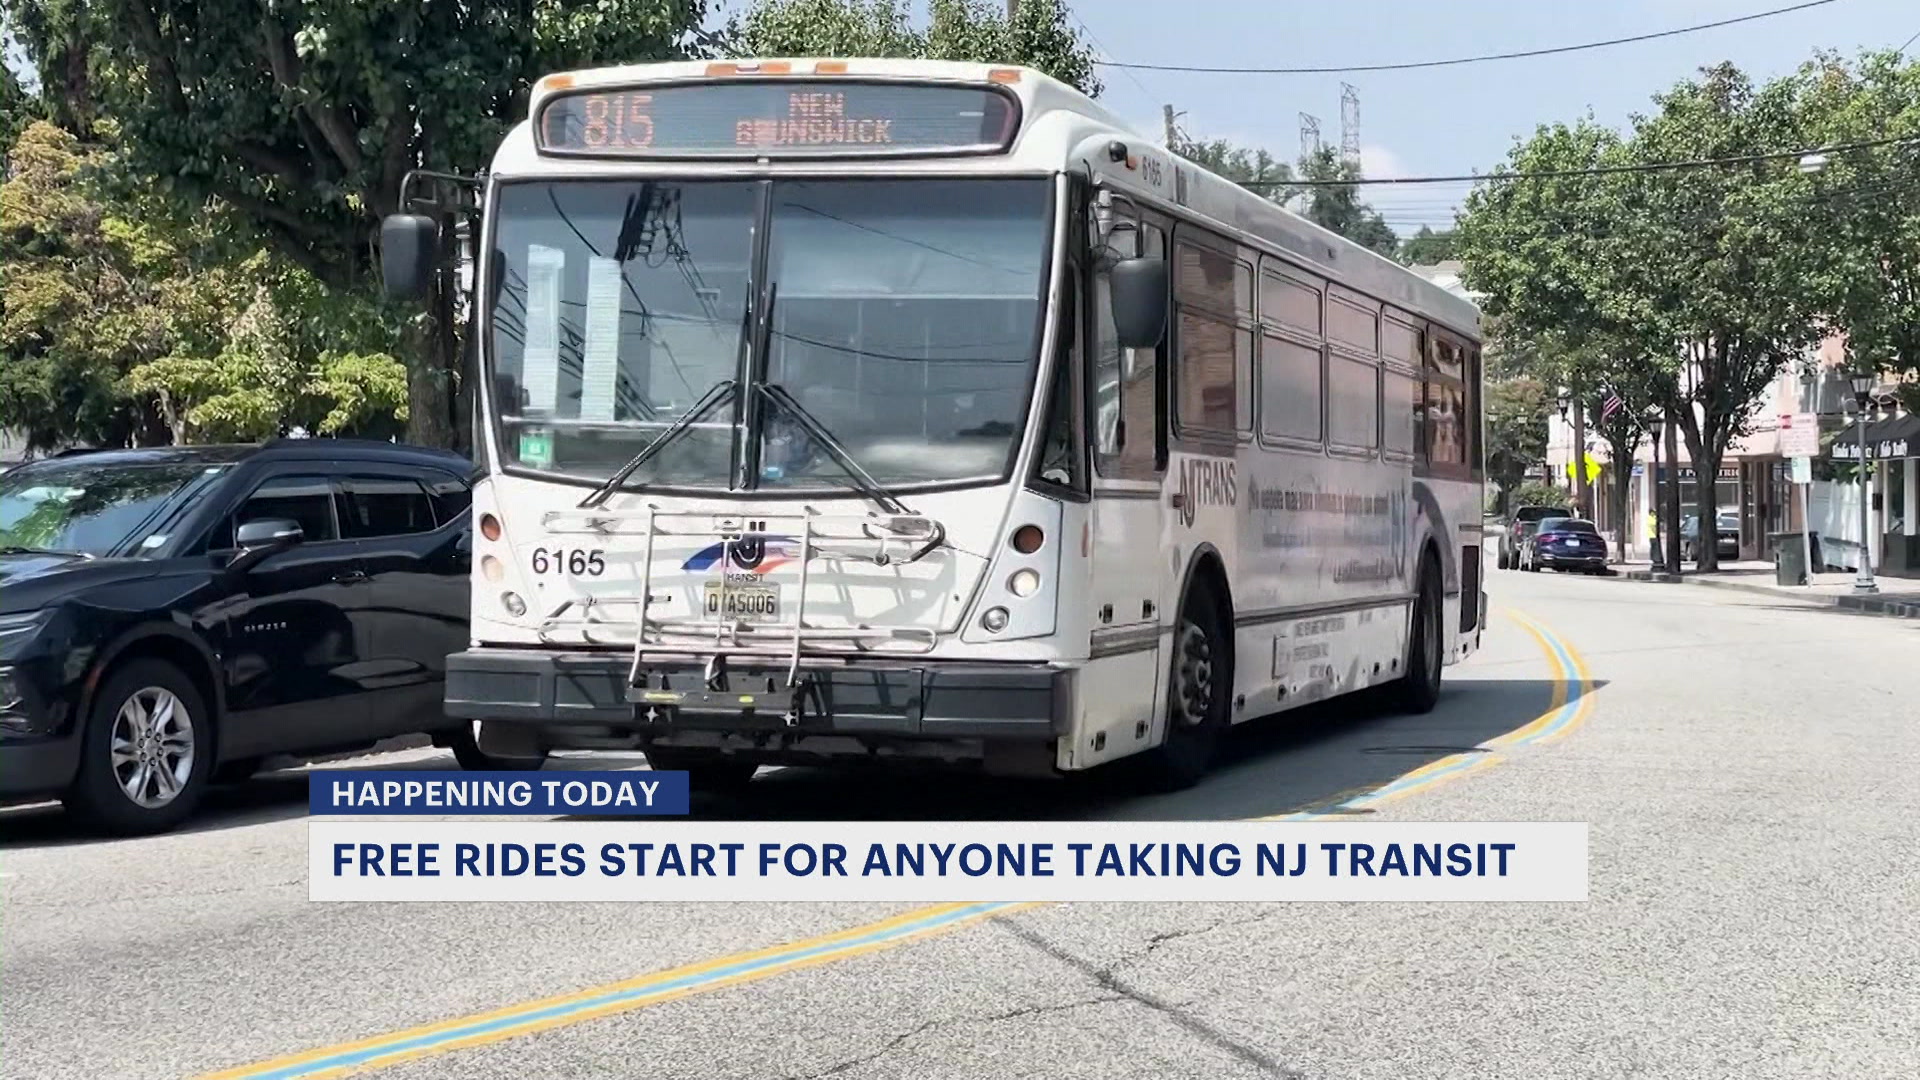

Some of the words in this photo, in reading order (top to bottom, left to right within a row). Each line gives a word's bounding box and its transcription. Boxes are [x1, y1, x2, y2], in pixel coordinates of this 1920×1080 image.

[789, 93, 844, 117] NEW
[584, 95, 654, 148] 815
[736, 119, 893, 145] BUNSWICK
[532, 547, 605, 576] 6165
